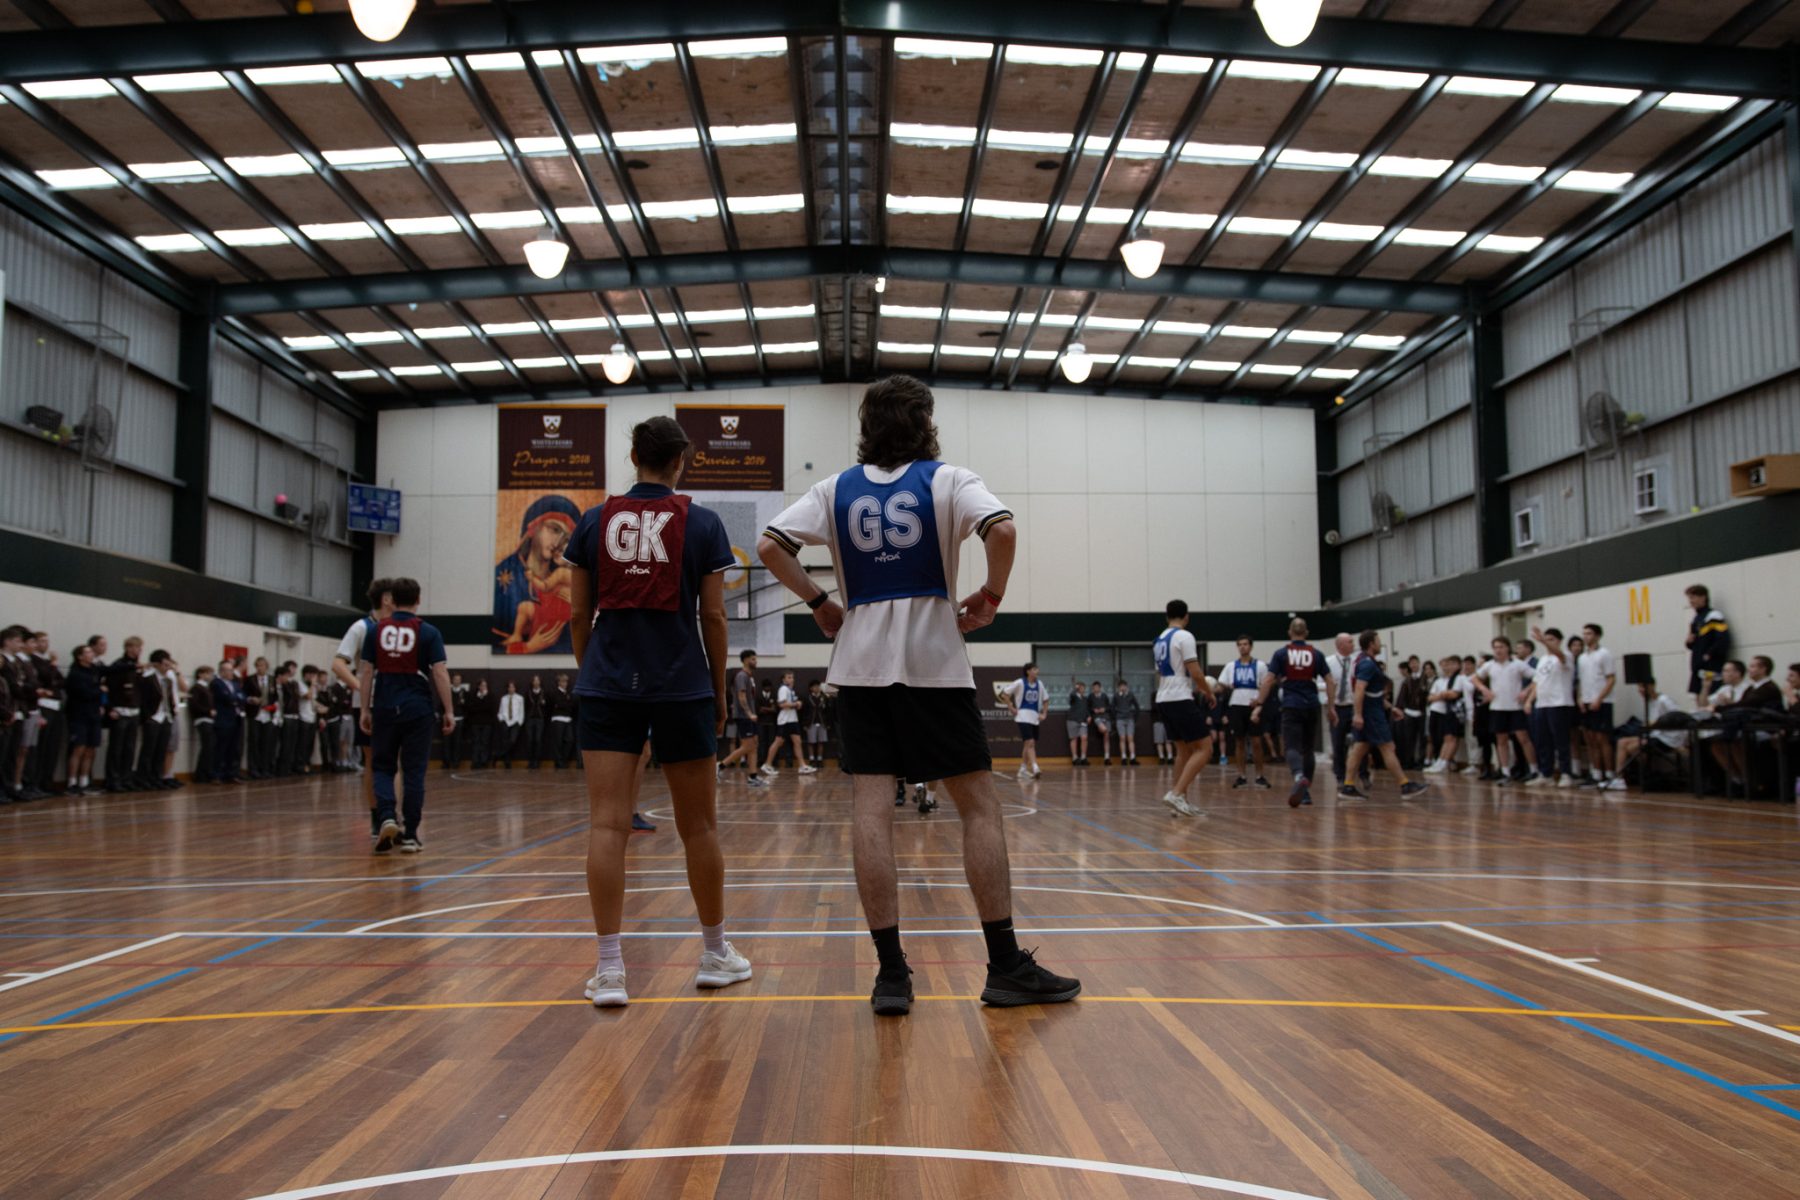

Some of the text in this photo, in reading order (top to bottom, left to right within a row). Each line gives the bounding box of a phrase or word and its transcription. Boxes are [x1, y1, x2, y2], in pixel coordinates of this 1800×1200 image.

[512, 450, 559, 468] Prayer
[743, 455, 767, 465] 2019
[848, 490, 923, 552] GS
[605, 510, 674, 563] GK
[1628, 585, 1651, 625] M
[380, 624, 416, 653] GD
[1287, 649, 1313, 668] WD
[1236, 667, 1255, 682] WA
